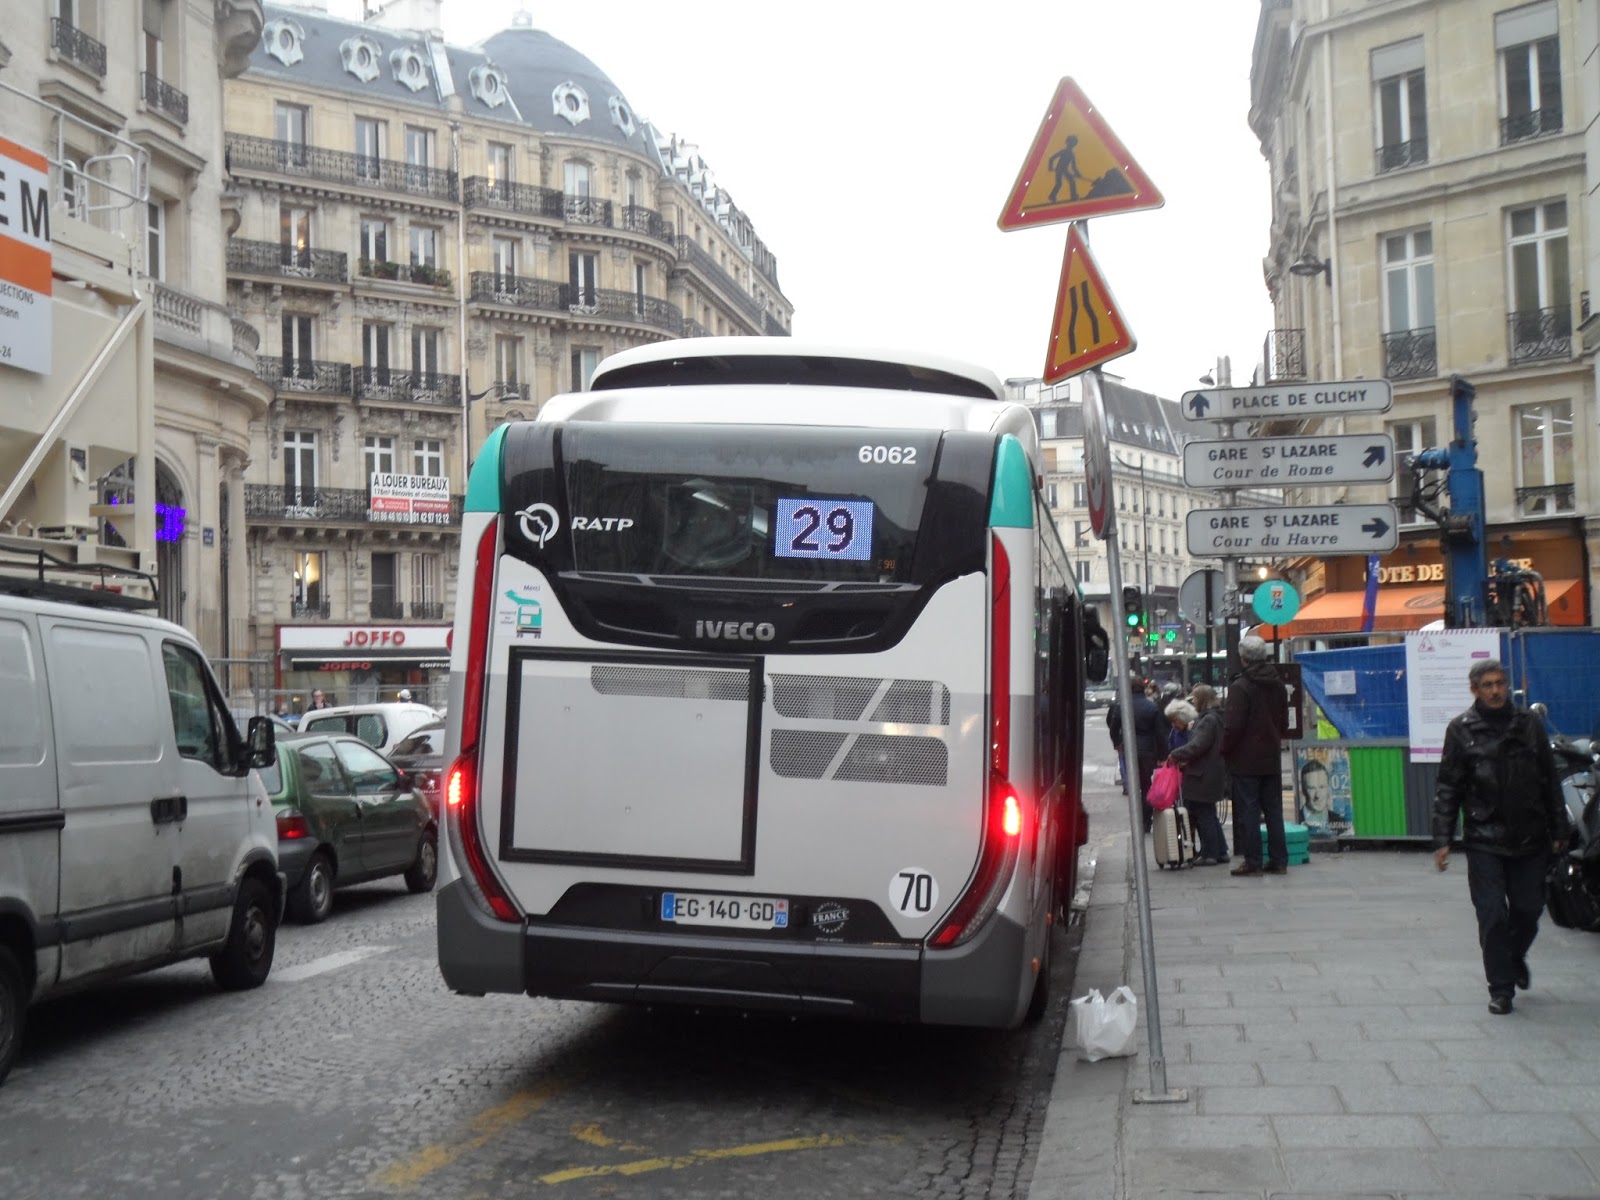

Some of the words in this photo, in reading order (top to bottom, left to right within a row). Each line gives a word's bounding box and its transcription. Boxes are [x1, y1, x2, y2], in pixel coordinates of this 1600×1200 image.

[1232, 394, 1279, 409] PLACE
[1288, 393, 1307, 405] DE
[1315, 389, 1367, 404] CLICHY
[858, 445, 917, 465] 6062
[1208, 447, 1248, 461] GARE
[1281, 444, 1338, 458] LAZARE
[1213, 467, 1253, 480] Cour
[1260, 466, 1279, 478] de
[1288, 464, 1334, 476] Rome
[382, 474, 408, 488] LOUER
[410, 477, 448, 491] BUREAUX
[571, 516, 634, 532] RATP
[792, 506, 854, 553] 29
[1210, 517, 1249, 530] GARE
[1283, 514, 1339, 527] LAZARE
[1213, 535, 1253, 548] Cour
[1261, 534, 1279, 546] du
[1287, 533, 1338, 546] Havre
[1417, 563, 1443, 581] DE
[343, 630, 406, 647] JOFFO
[695, 619, 776, 642] IVECO
[899, 873, 932, 912] 70
[675, 898, 774, 921] EG-140-GD
[776, 912, 787, 924] 75
[813, 910, 849, 923] FRANCE
